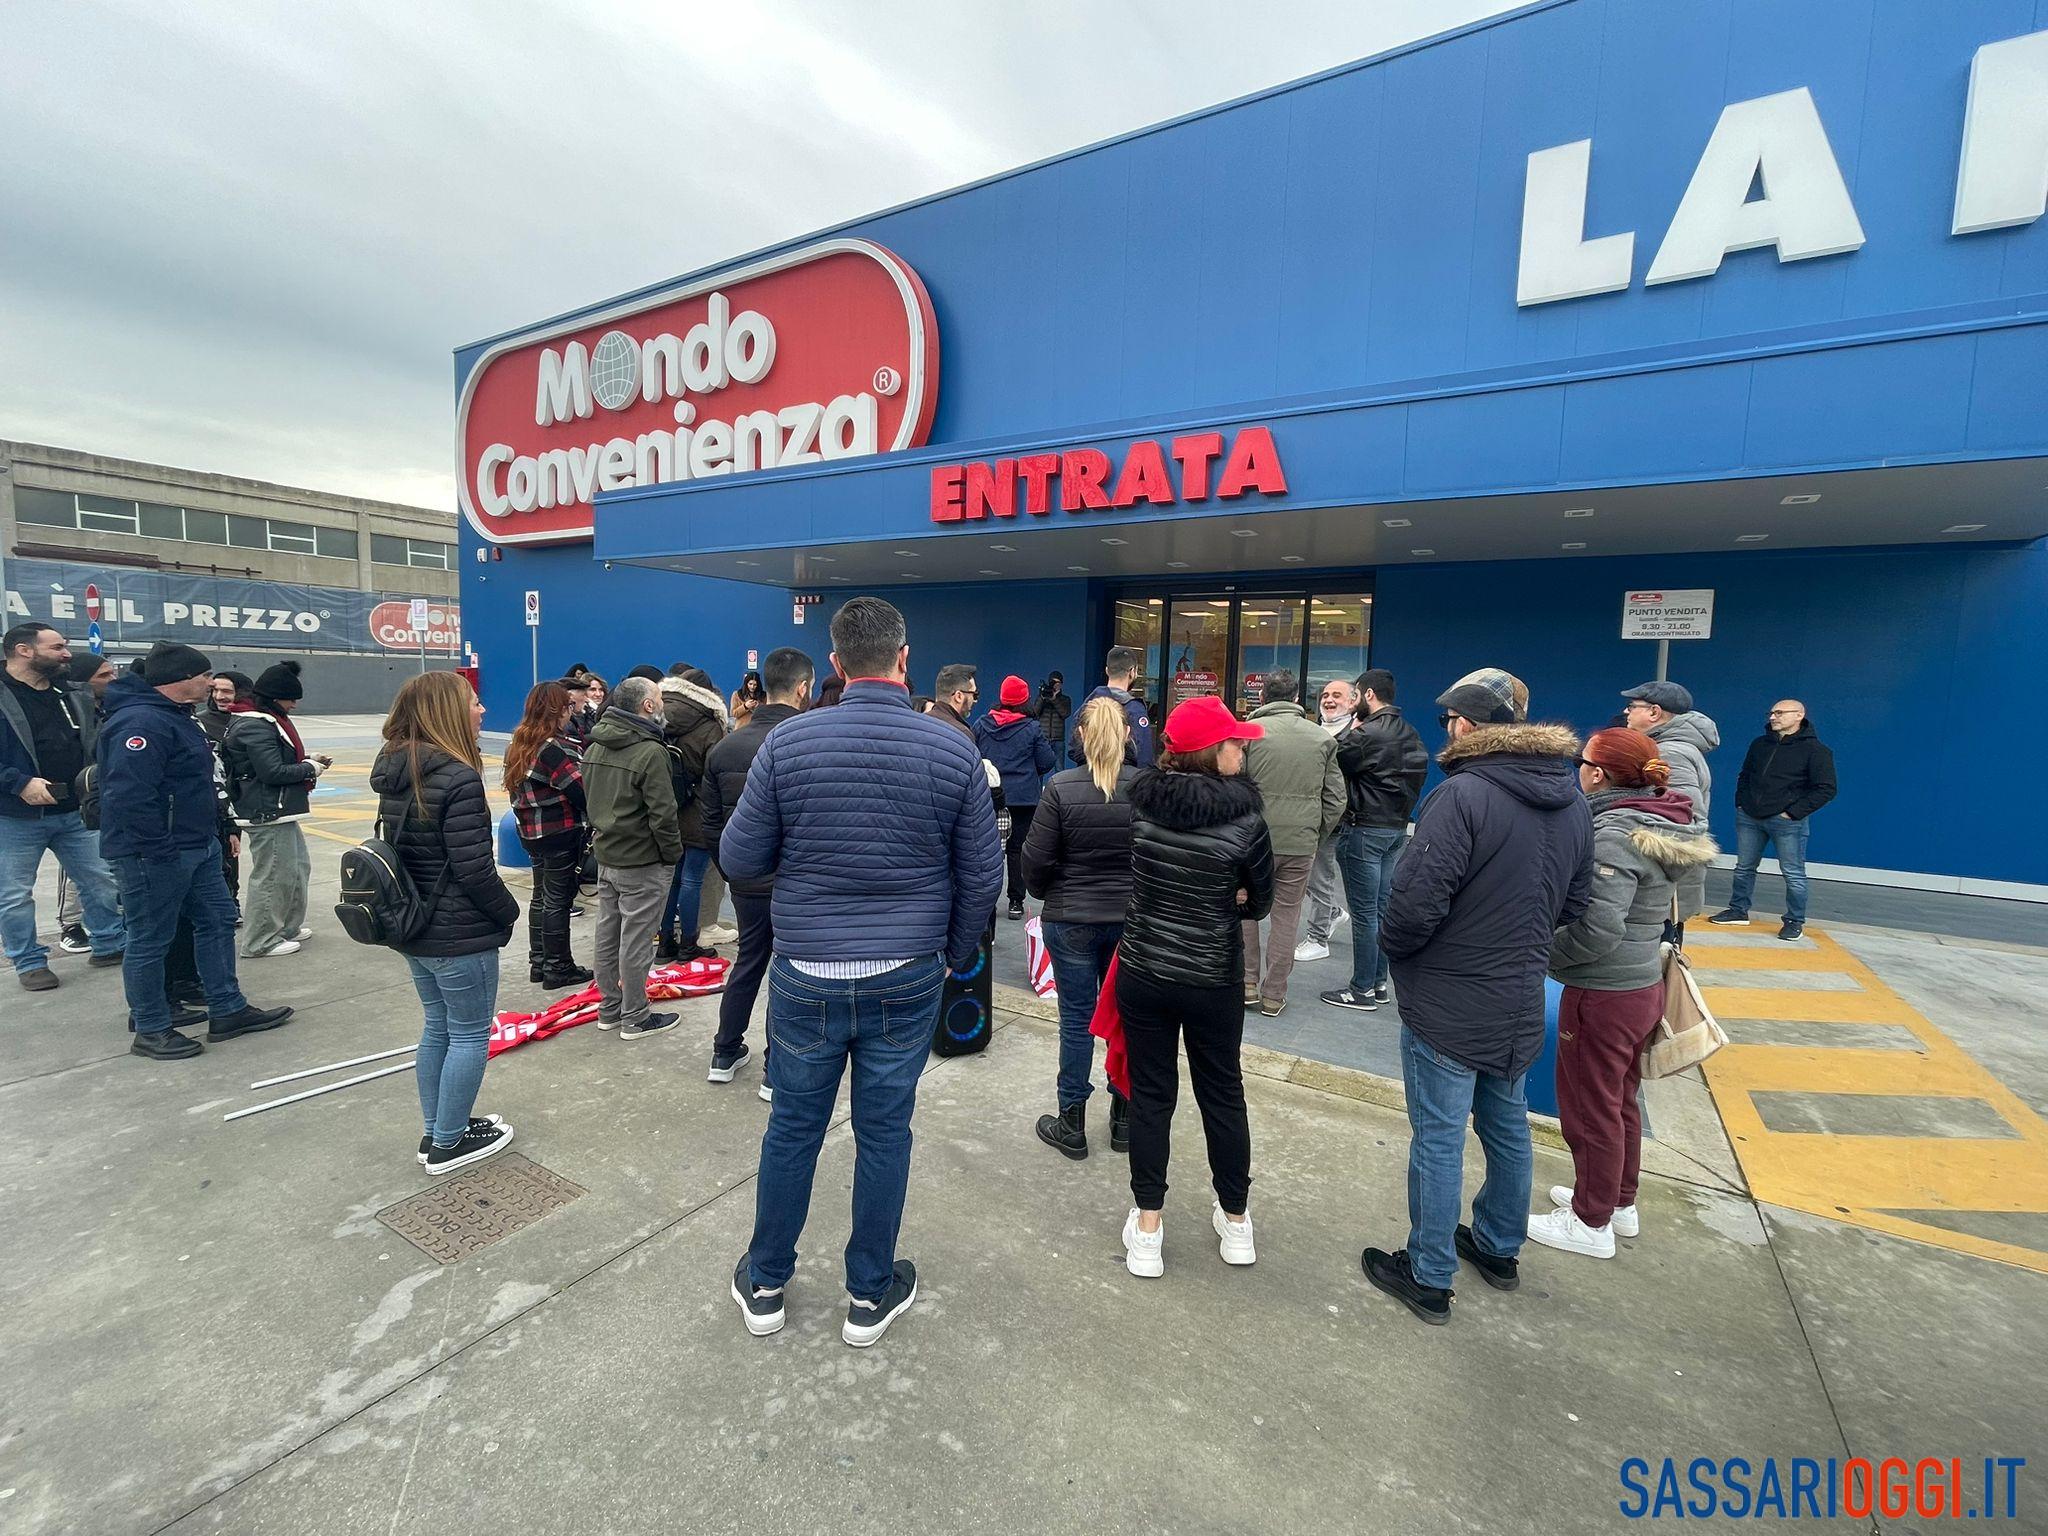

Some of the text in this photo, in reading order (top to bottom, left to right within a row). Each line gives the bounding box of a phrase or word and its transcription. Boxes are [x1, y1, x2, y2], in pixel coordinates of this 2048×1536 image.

[1517, 86, 1866, 307] LA
[535, 291, 777, 427] Mondo
[931, 426, 1288, 523] ENTRATA
[104, 598, 144, 623] IL
[1628, 607, 1708, 616] PUNTO VENDITA
